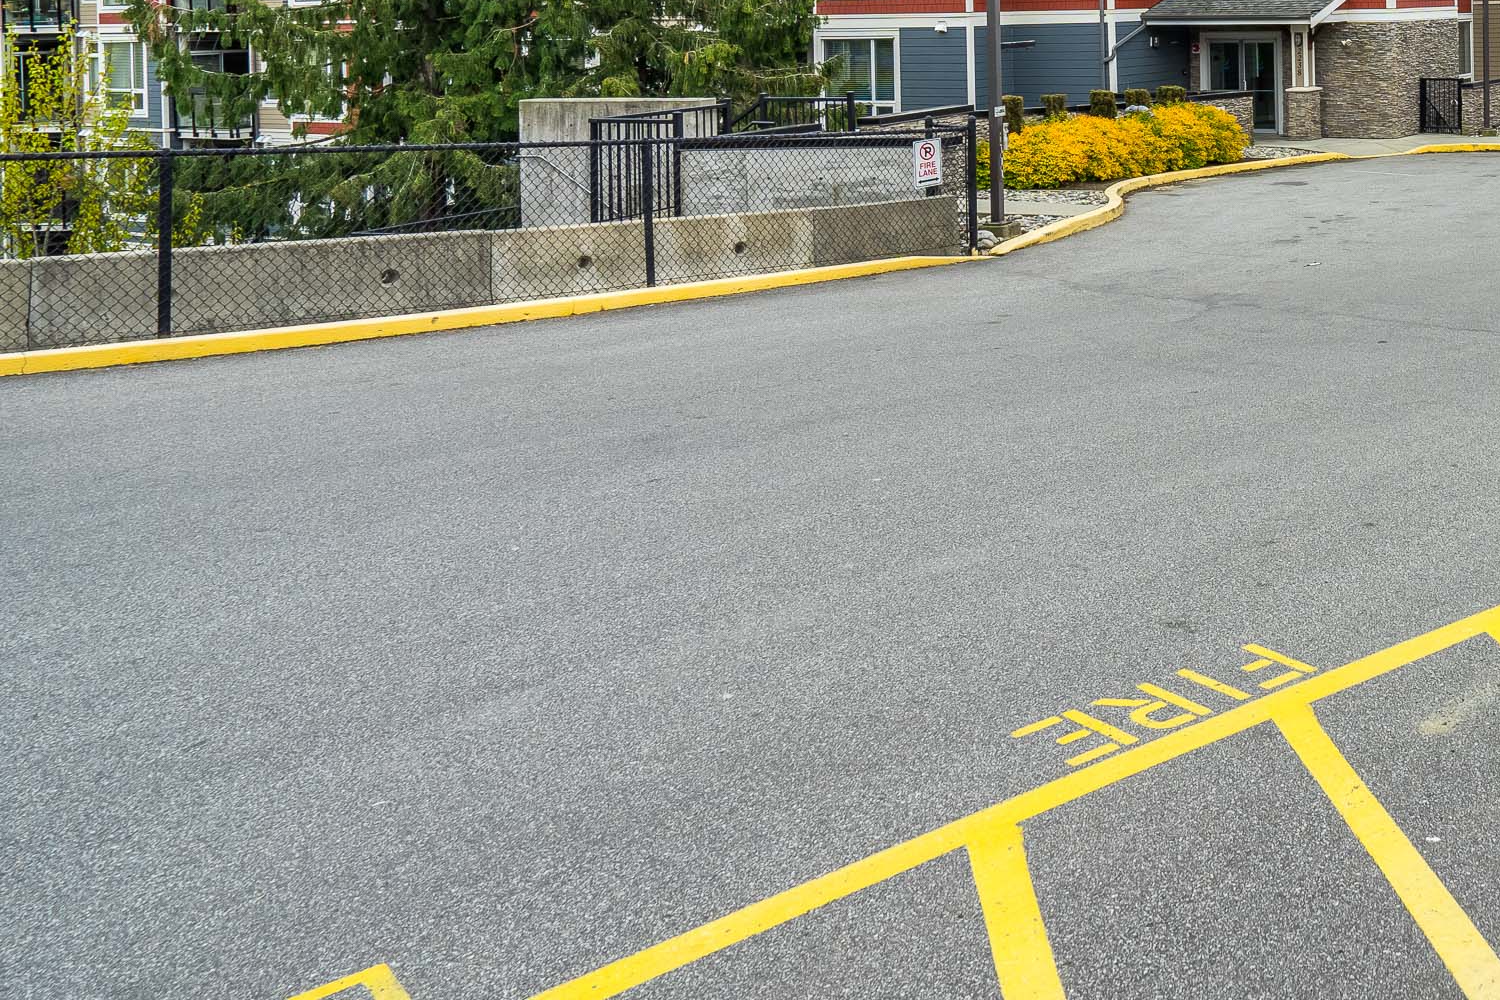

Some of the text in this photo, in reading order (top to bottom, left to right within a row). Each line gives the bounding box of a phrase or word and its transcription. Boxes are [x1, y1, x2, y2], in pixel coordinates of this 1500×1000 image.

[919, 160, 937, 170] FIRE
[918, 168, 938, 178] LANE
[1010, 643, 1318, 767] FIRE
